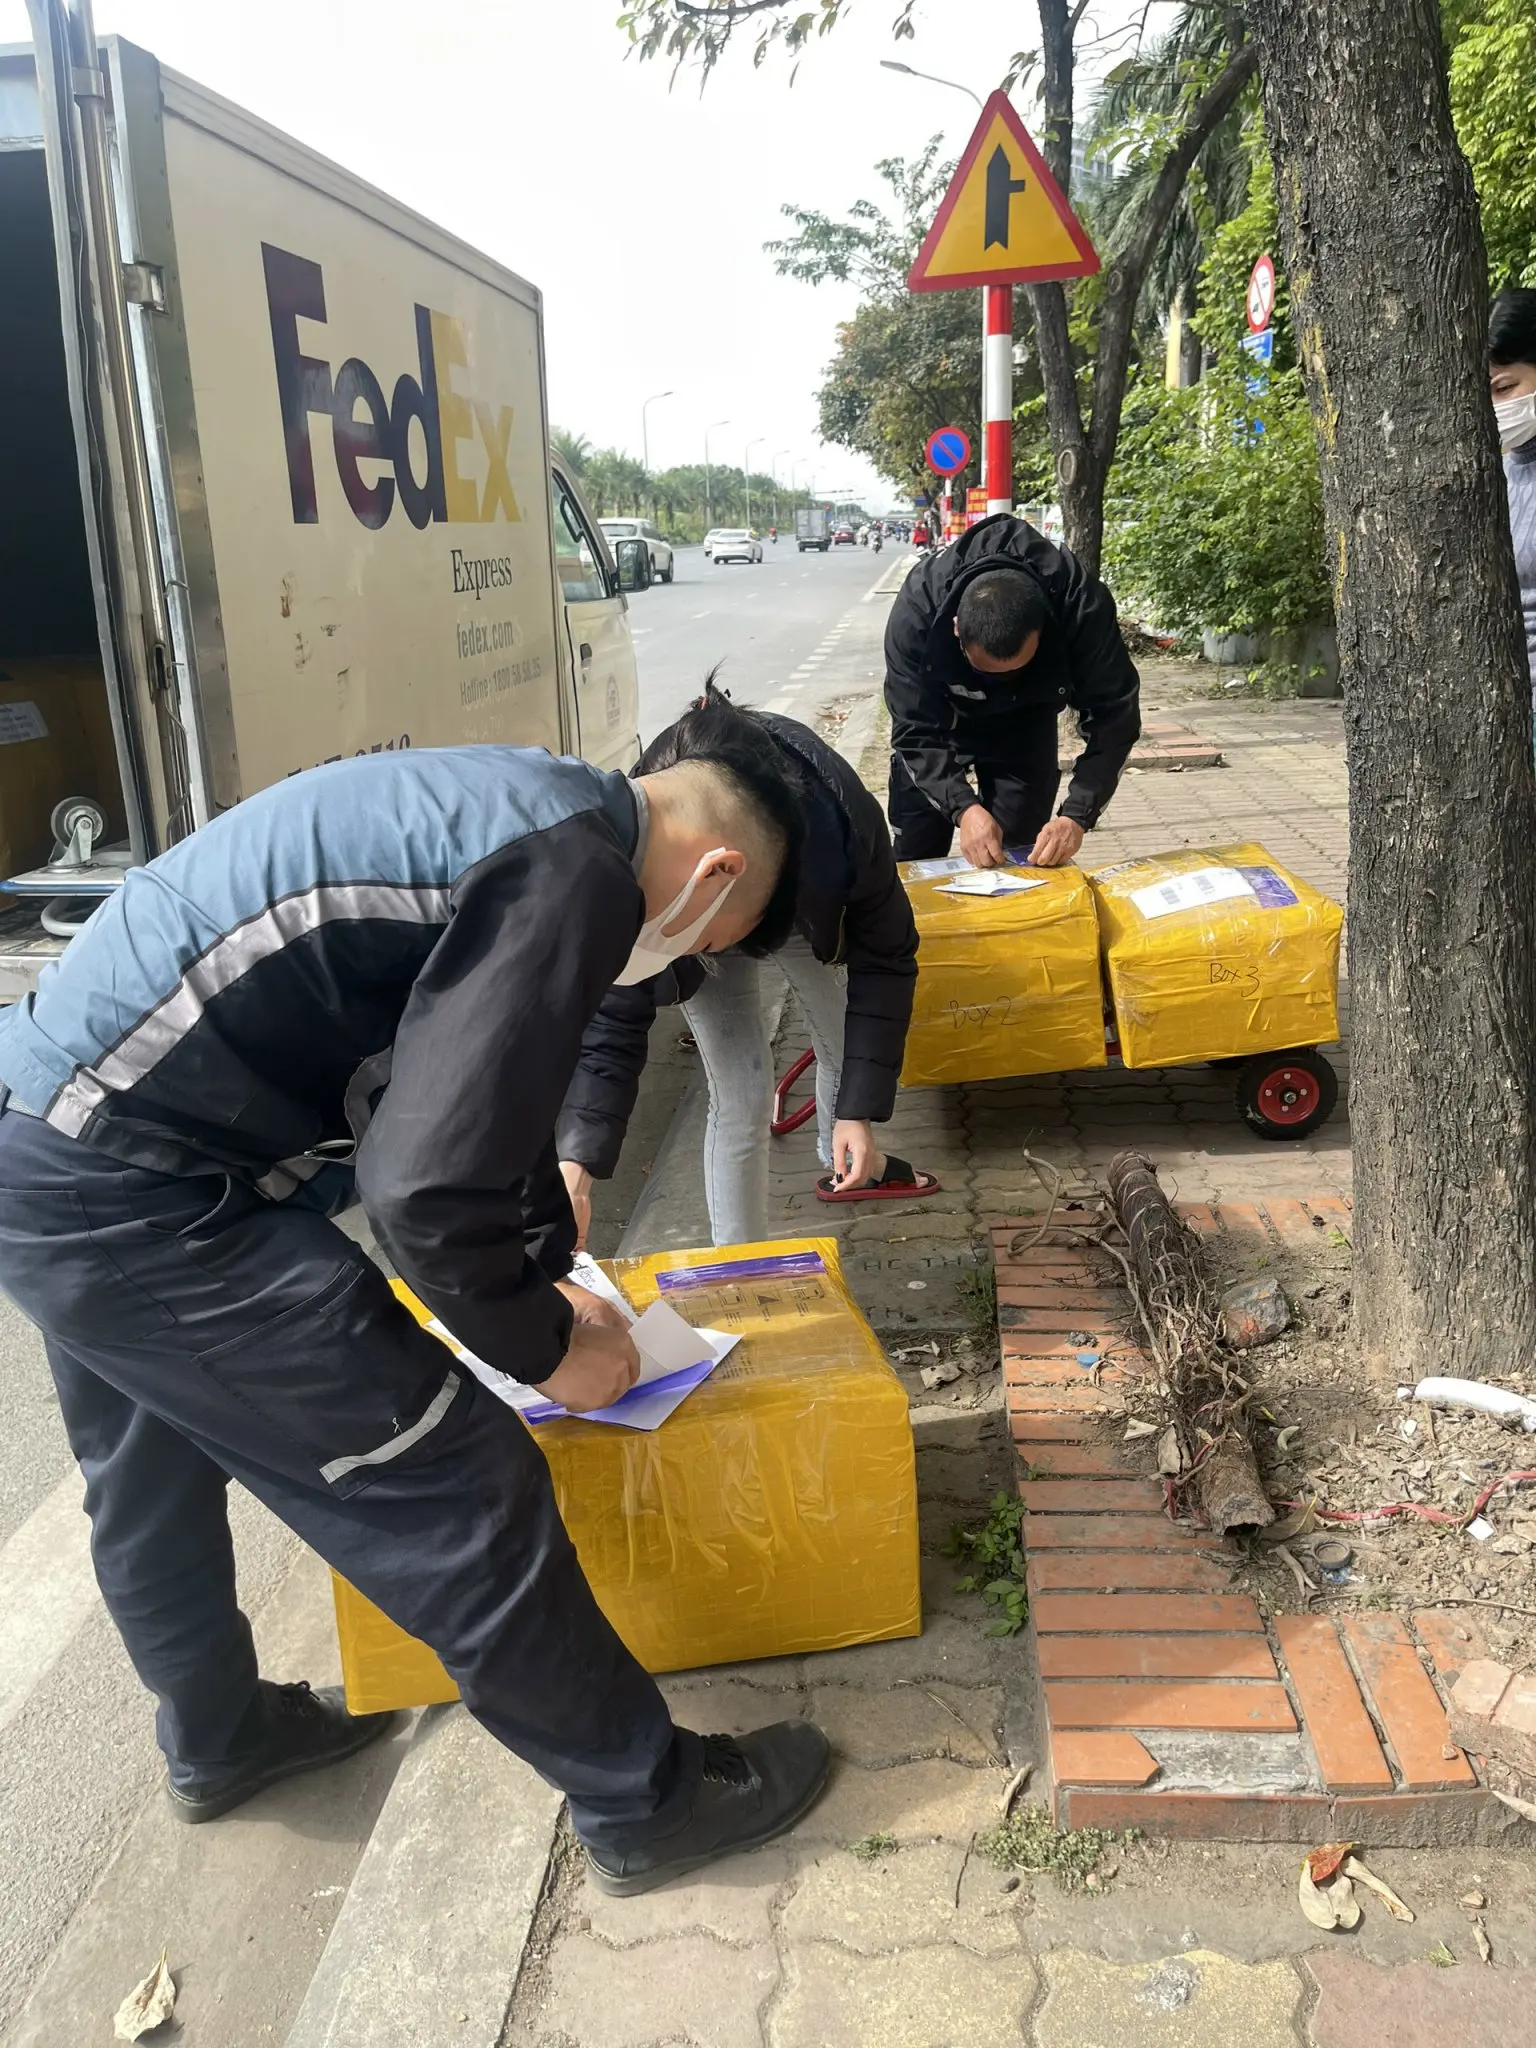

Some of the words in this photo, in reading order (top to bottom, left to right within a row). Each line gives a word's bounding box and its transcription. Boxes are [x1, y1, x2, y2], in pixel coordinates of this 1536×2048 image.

[261, 241, 522, 530] FedEx
[450, 549, 512, 601] Express
[456, 620, 514, 659] fedex.com
[1240, 965, 1260, 998] 3
[997, 995, 1028, 1025] 2
